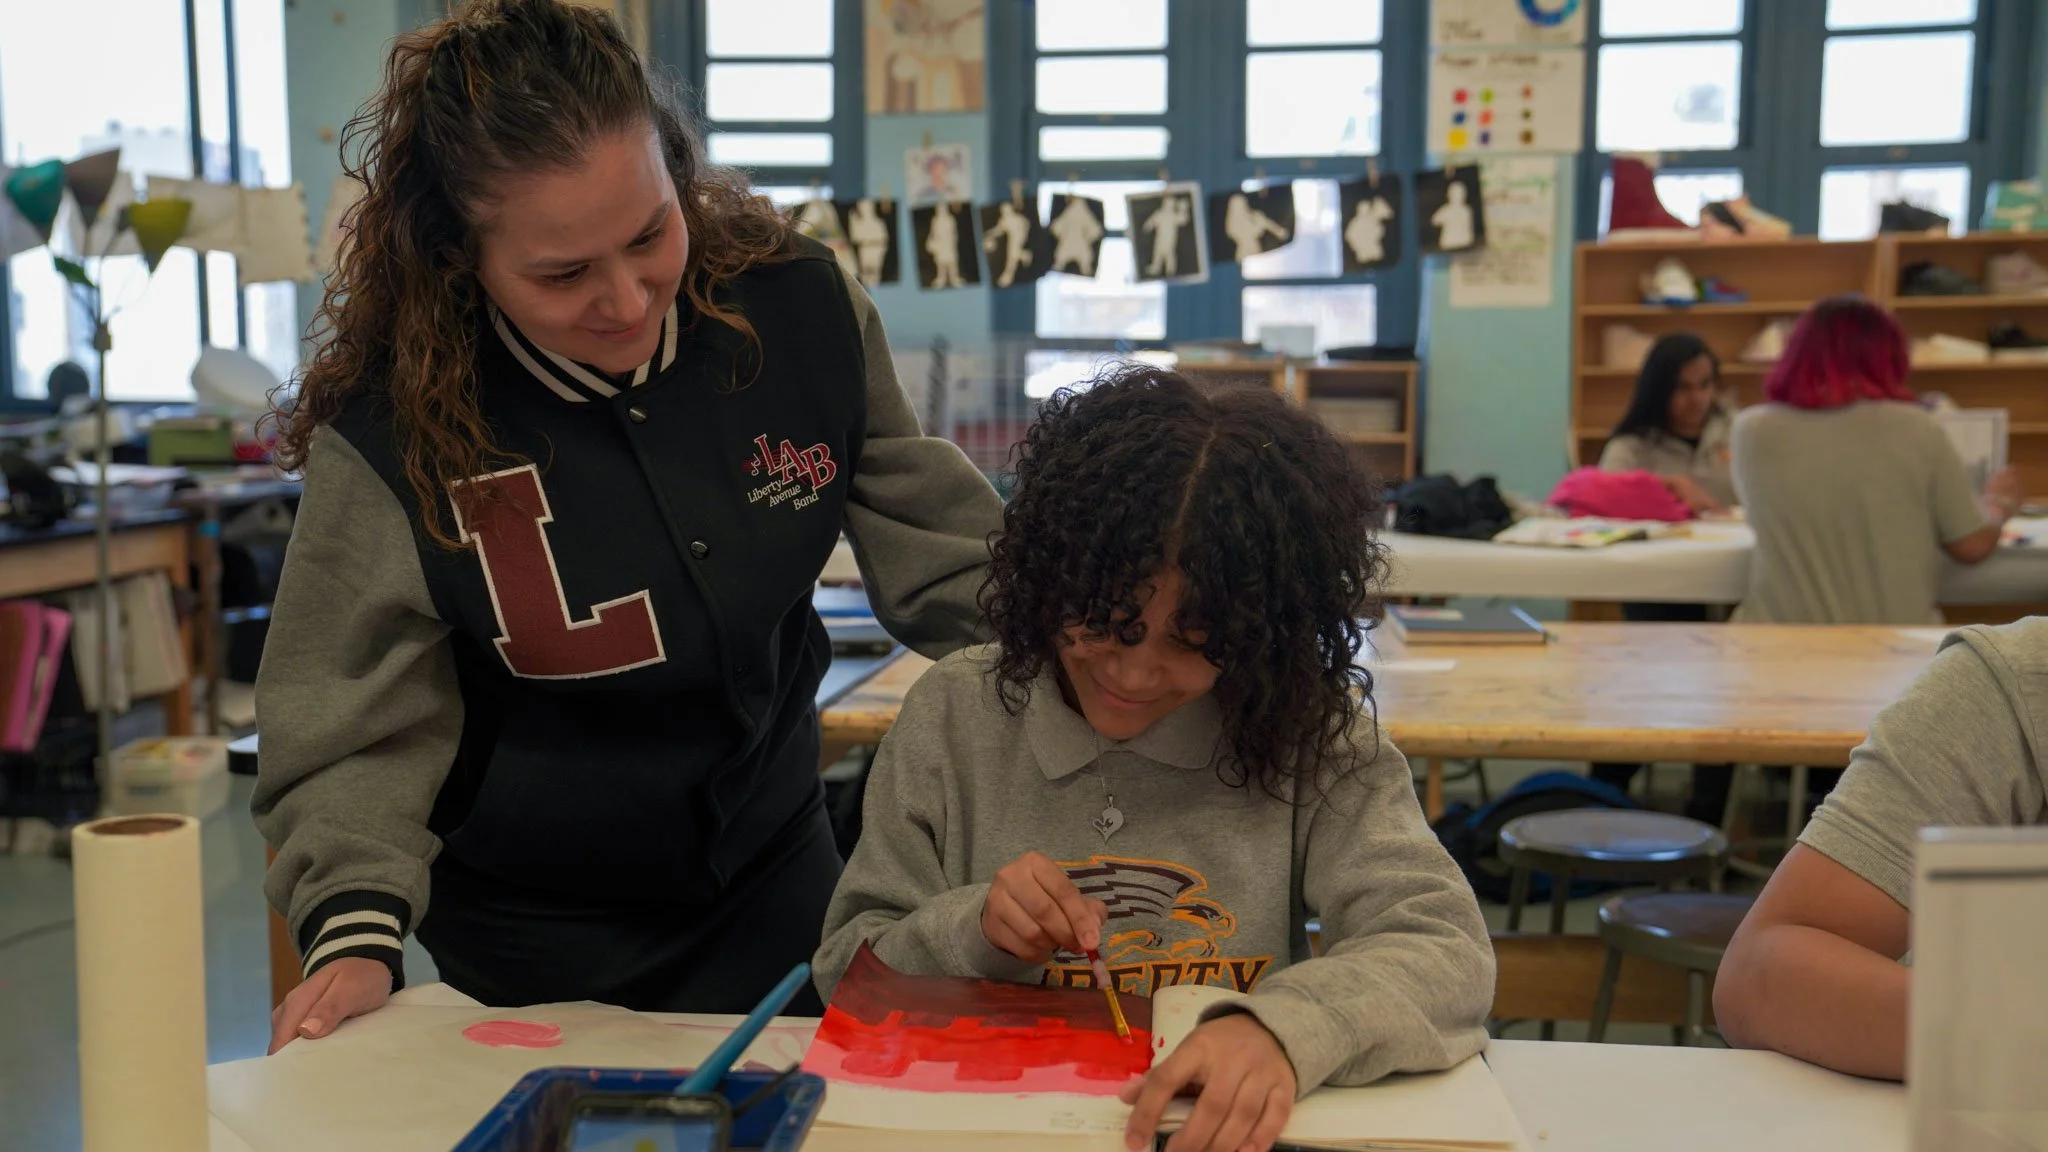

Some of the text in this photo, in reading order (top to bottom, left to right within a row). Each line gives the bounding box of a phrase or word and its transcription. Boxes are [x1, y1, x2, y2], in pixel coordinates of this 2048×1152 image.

[754, 432, 837, 490] LAB
[747, 480, 782, 503] Liberty
[769, 484, 802, 508] Avenue
[793, 489, 819, 511] Band
[449, 463, 667, 680] L
